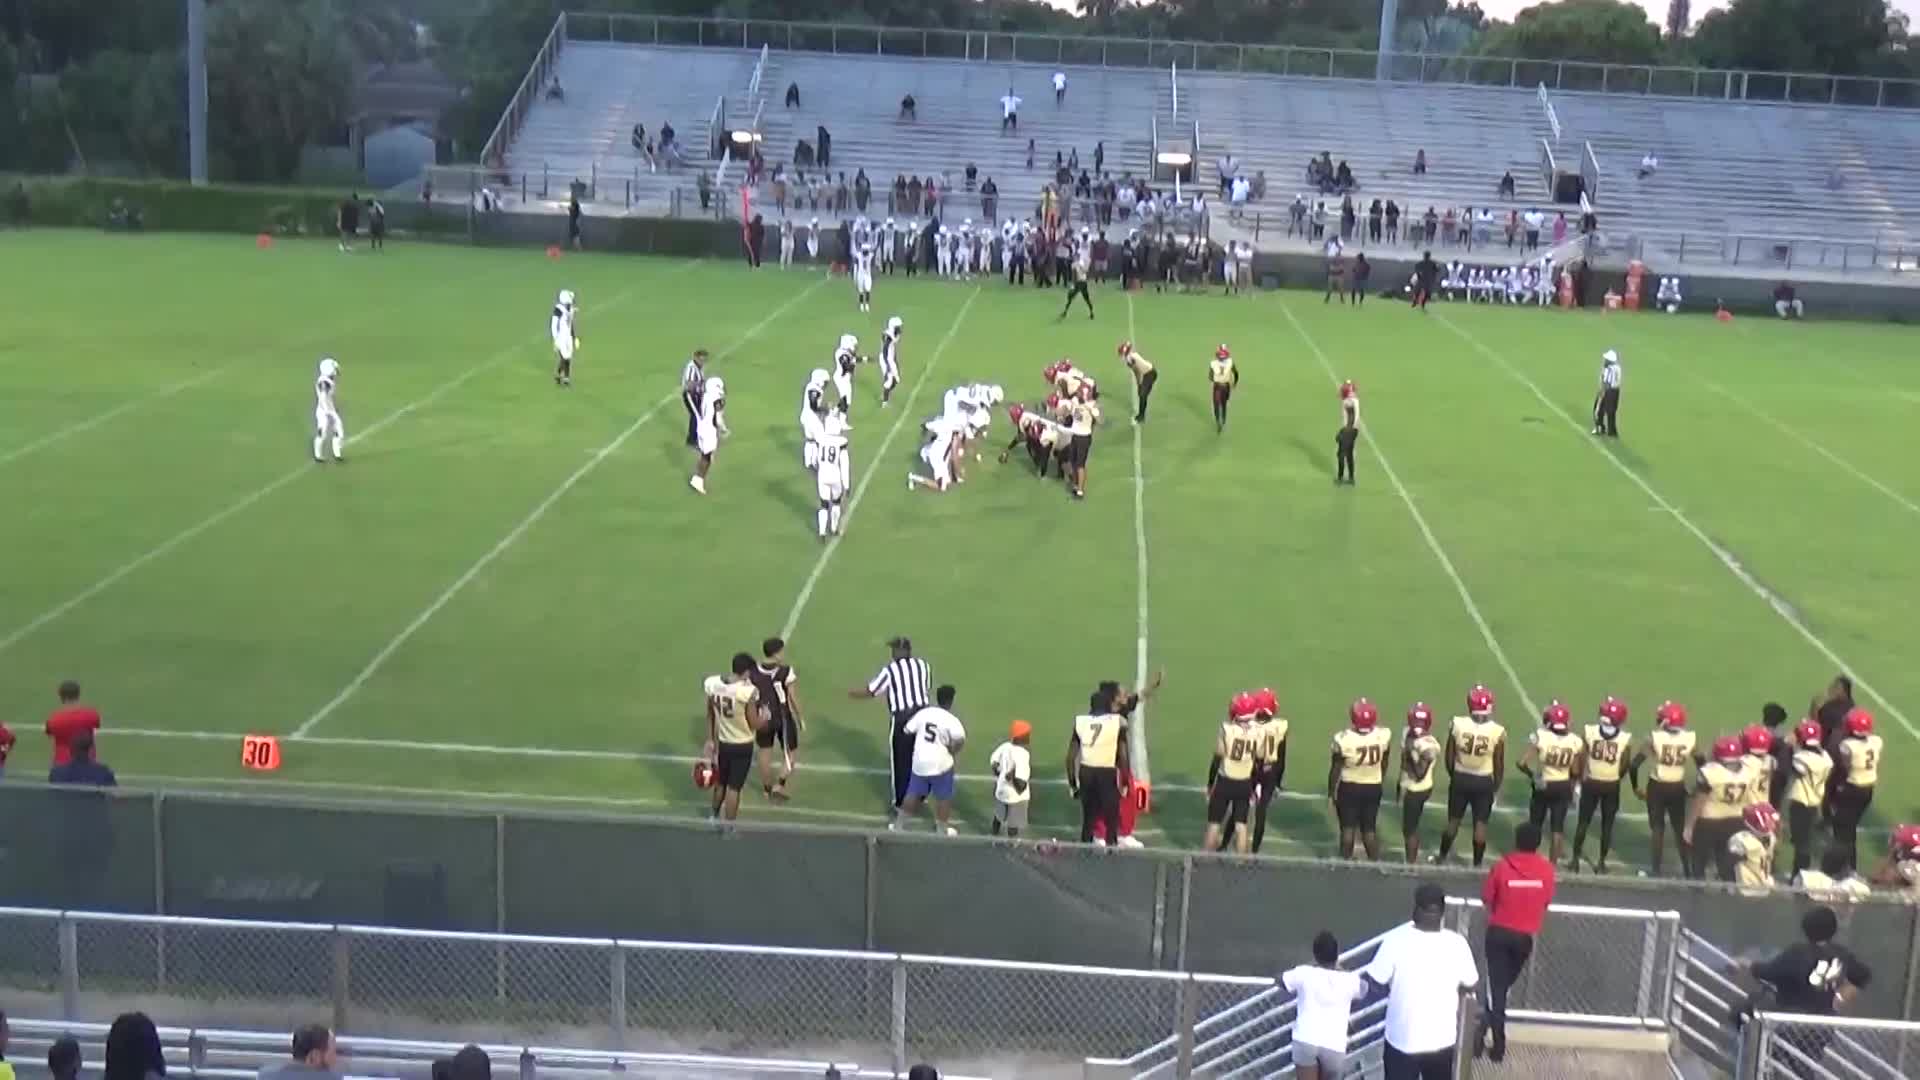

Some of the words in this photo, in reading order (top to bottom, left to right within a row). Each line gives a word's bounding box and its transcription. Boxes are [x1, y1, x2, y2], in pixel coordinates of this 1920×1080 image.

[821, 446, 836, 464] 19
[924, 722, 937, 743] 5
[1090, 724, 1102, 747] 7
[245, 741, 270, 767] 30
[1461, 732, 1490, 756] 32
[1356, 745, 1380, 766] 70
[1865, 748, 1875, 770] 2
[1136, 787, 1146, 810] 0
